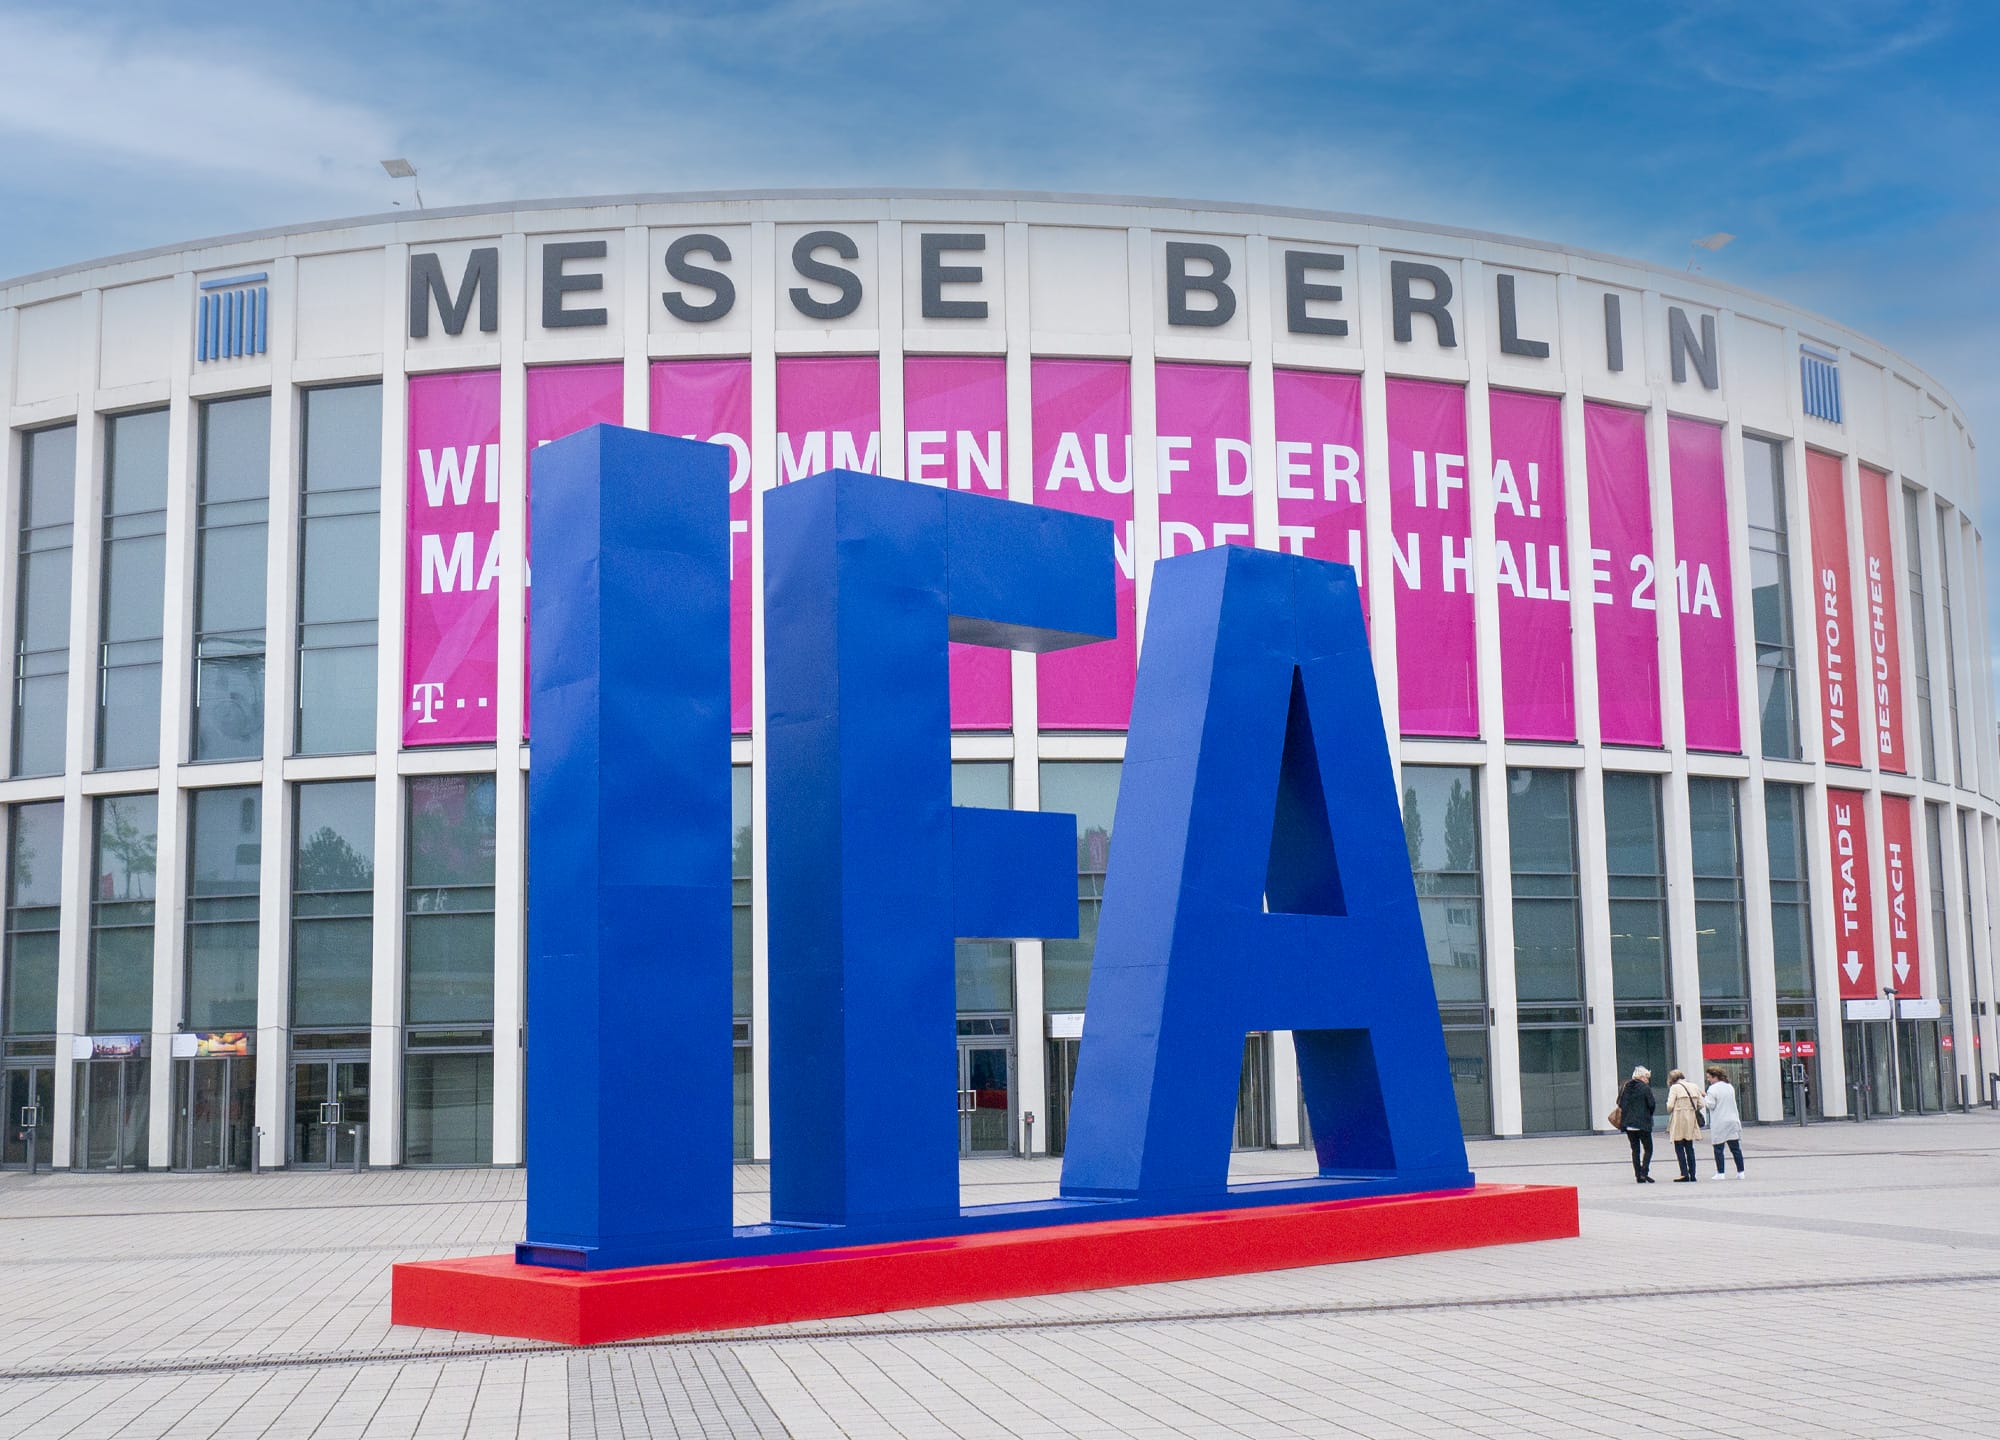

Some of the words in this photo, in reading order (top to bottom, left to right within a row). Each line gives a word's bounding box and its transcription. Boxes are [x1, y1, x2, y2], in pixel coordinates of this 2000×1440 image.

[410, 231, 988, 338] MESSE
[1165, 241, 1719, 391] BERLIN
[418, 430, 1002, 507] WIOMMEN
[1045, 432, 1192, 494] AUF
[1215, 438, 1363, 504] DER
[1413, 451, 1541, 518] IFA!
[1348, 529, 1421, 590] IN
[1442, 535, 1614, 606] HALLE
[1630, 554, 1722, 618] 21A
[1822, 568, 1846, 747] VISITORS
[1870, 555, 1893, 754] BESUCHER
[528, 424, 1475, 1270] IFA
[1836, 804, 1859, 937] TRADE
[1889, 843, 1907, 939] FACH
